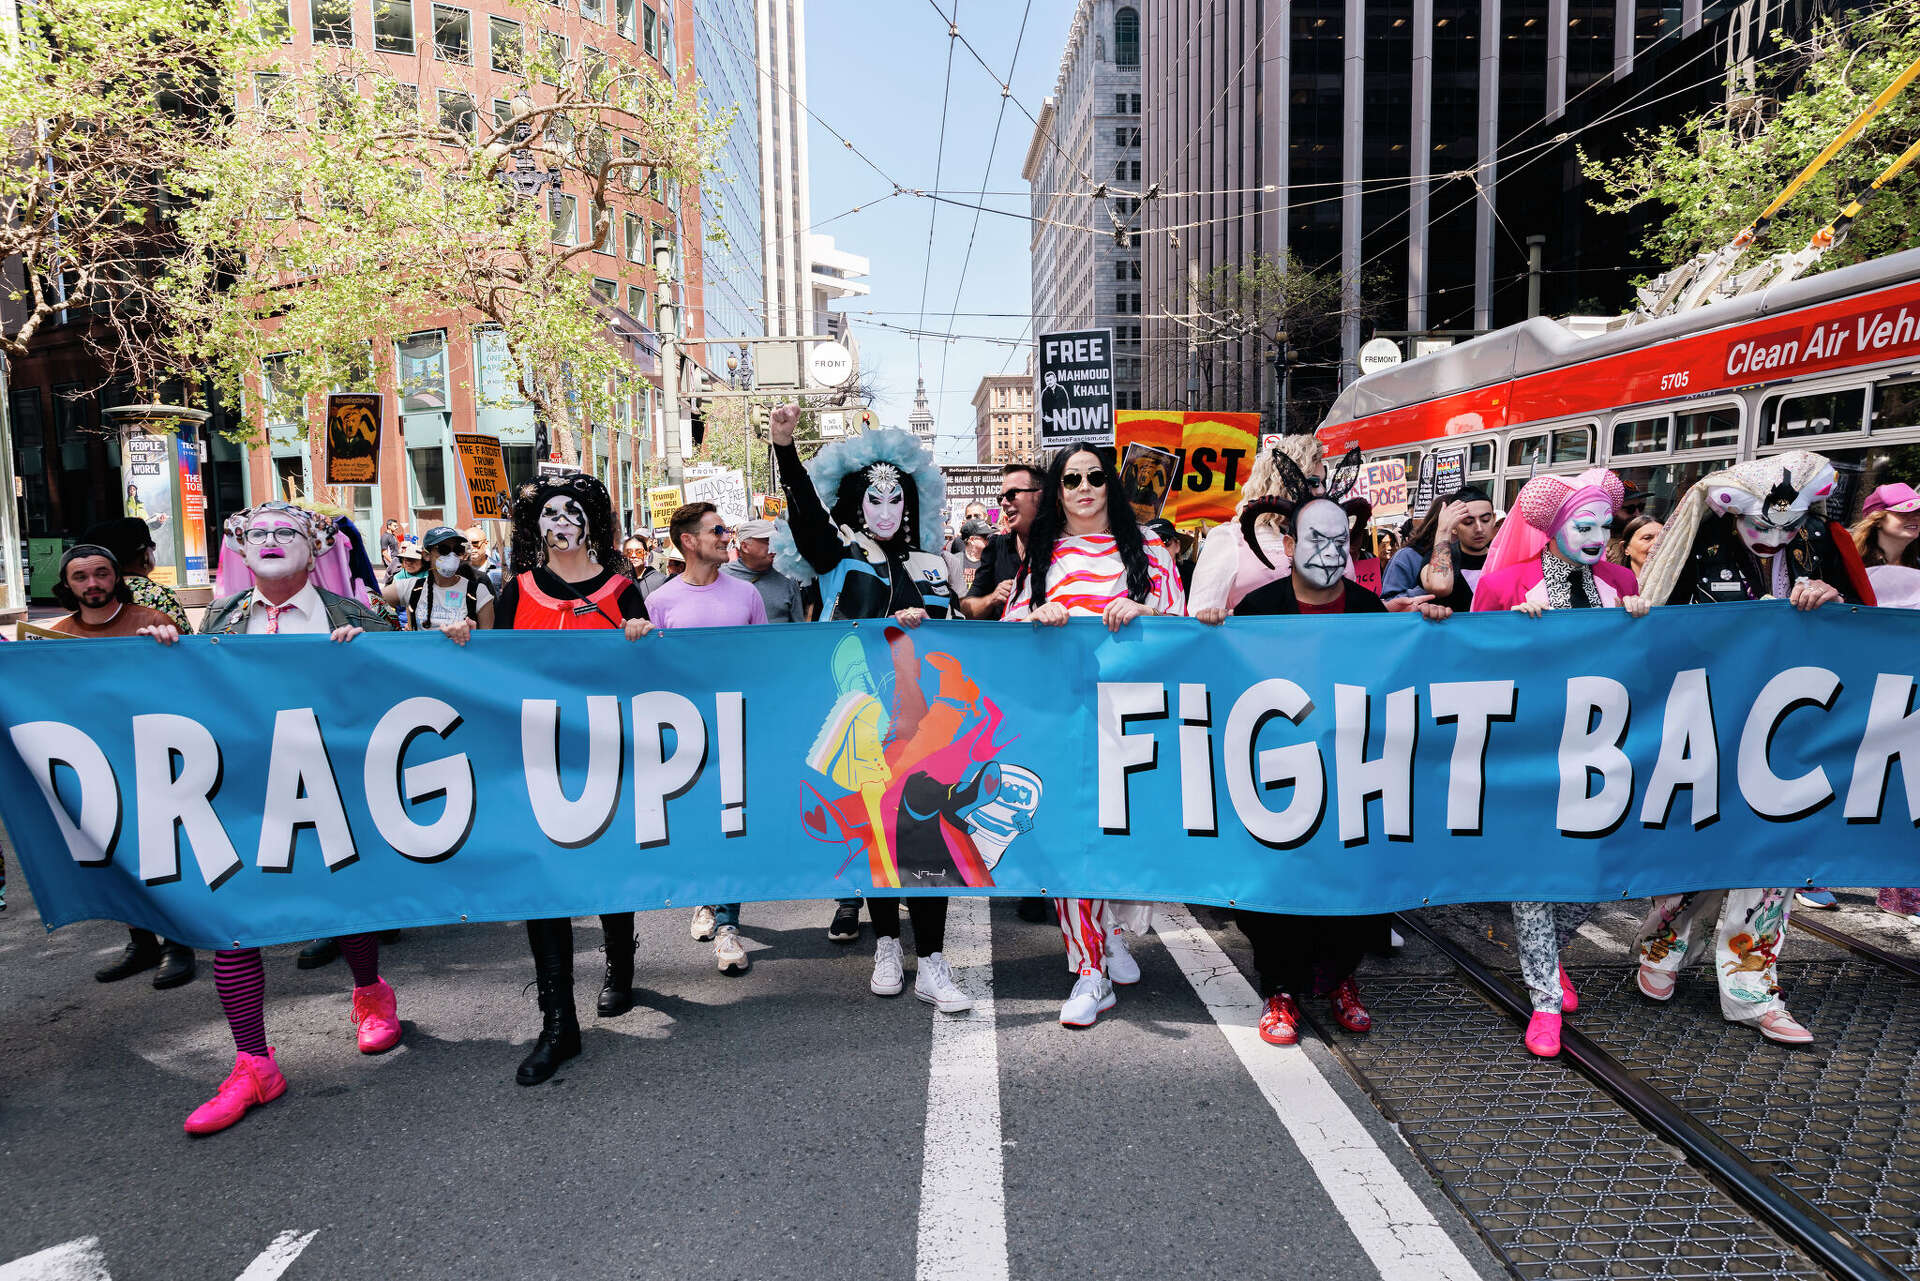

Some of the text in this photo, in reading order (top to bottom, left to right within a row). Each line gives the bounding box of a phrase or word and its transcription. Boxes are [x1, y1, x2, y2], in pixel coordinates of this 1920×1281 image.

[1046, 338, 1104, 364] FREE
[1726, 340, 1799, 376] Clean
[1801, 322, 1850, 362] Air
[814, 360, 847, 368] FRONT
[1365, 355, 1397, 363] FREMONT
[1057, 368, 1110, 382] MAHMOUD
[1660, 370, 1690, 391] 5705
[1073, 384, 1110, 397] KHALIL
[1052, 403, 1109, 431] NOW!
[130, 441, 163, 451] PEOPLE.
[459, 445, 474, 455] THE
[131, 454, 146, 462] REAL
[473, 456, 495, 466] TRUMP
[133, 464, 159, 474] WORK.
[1367, 463, 1405, 485] END
[469, 478, 496, 493] MUST
[954, 475, 972, 483] NAME
[973, 475, 981, 483] OF
[947, 485, 974, 494] REFUSE
[975, 485, 985, 494] TO
[1369, 484, 1406, 507] DOGE
[473, 495, 498, 515] GO!
[9, 690, 747, 892] DRAG UP!
